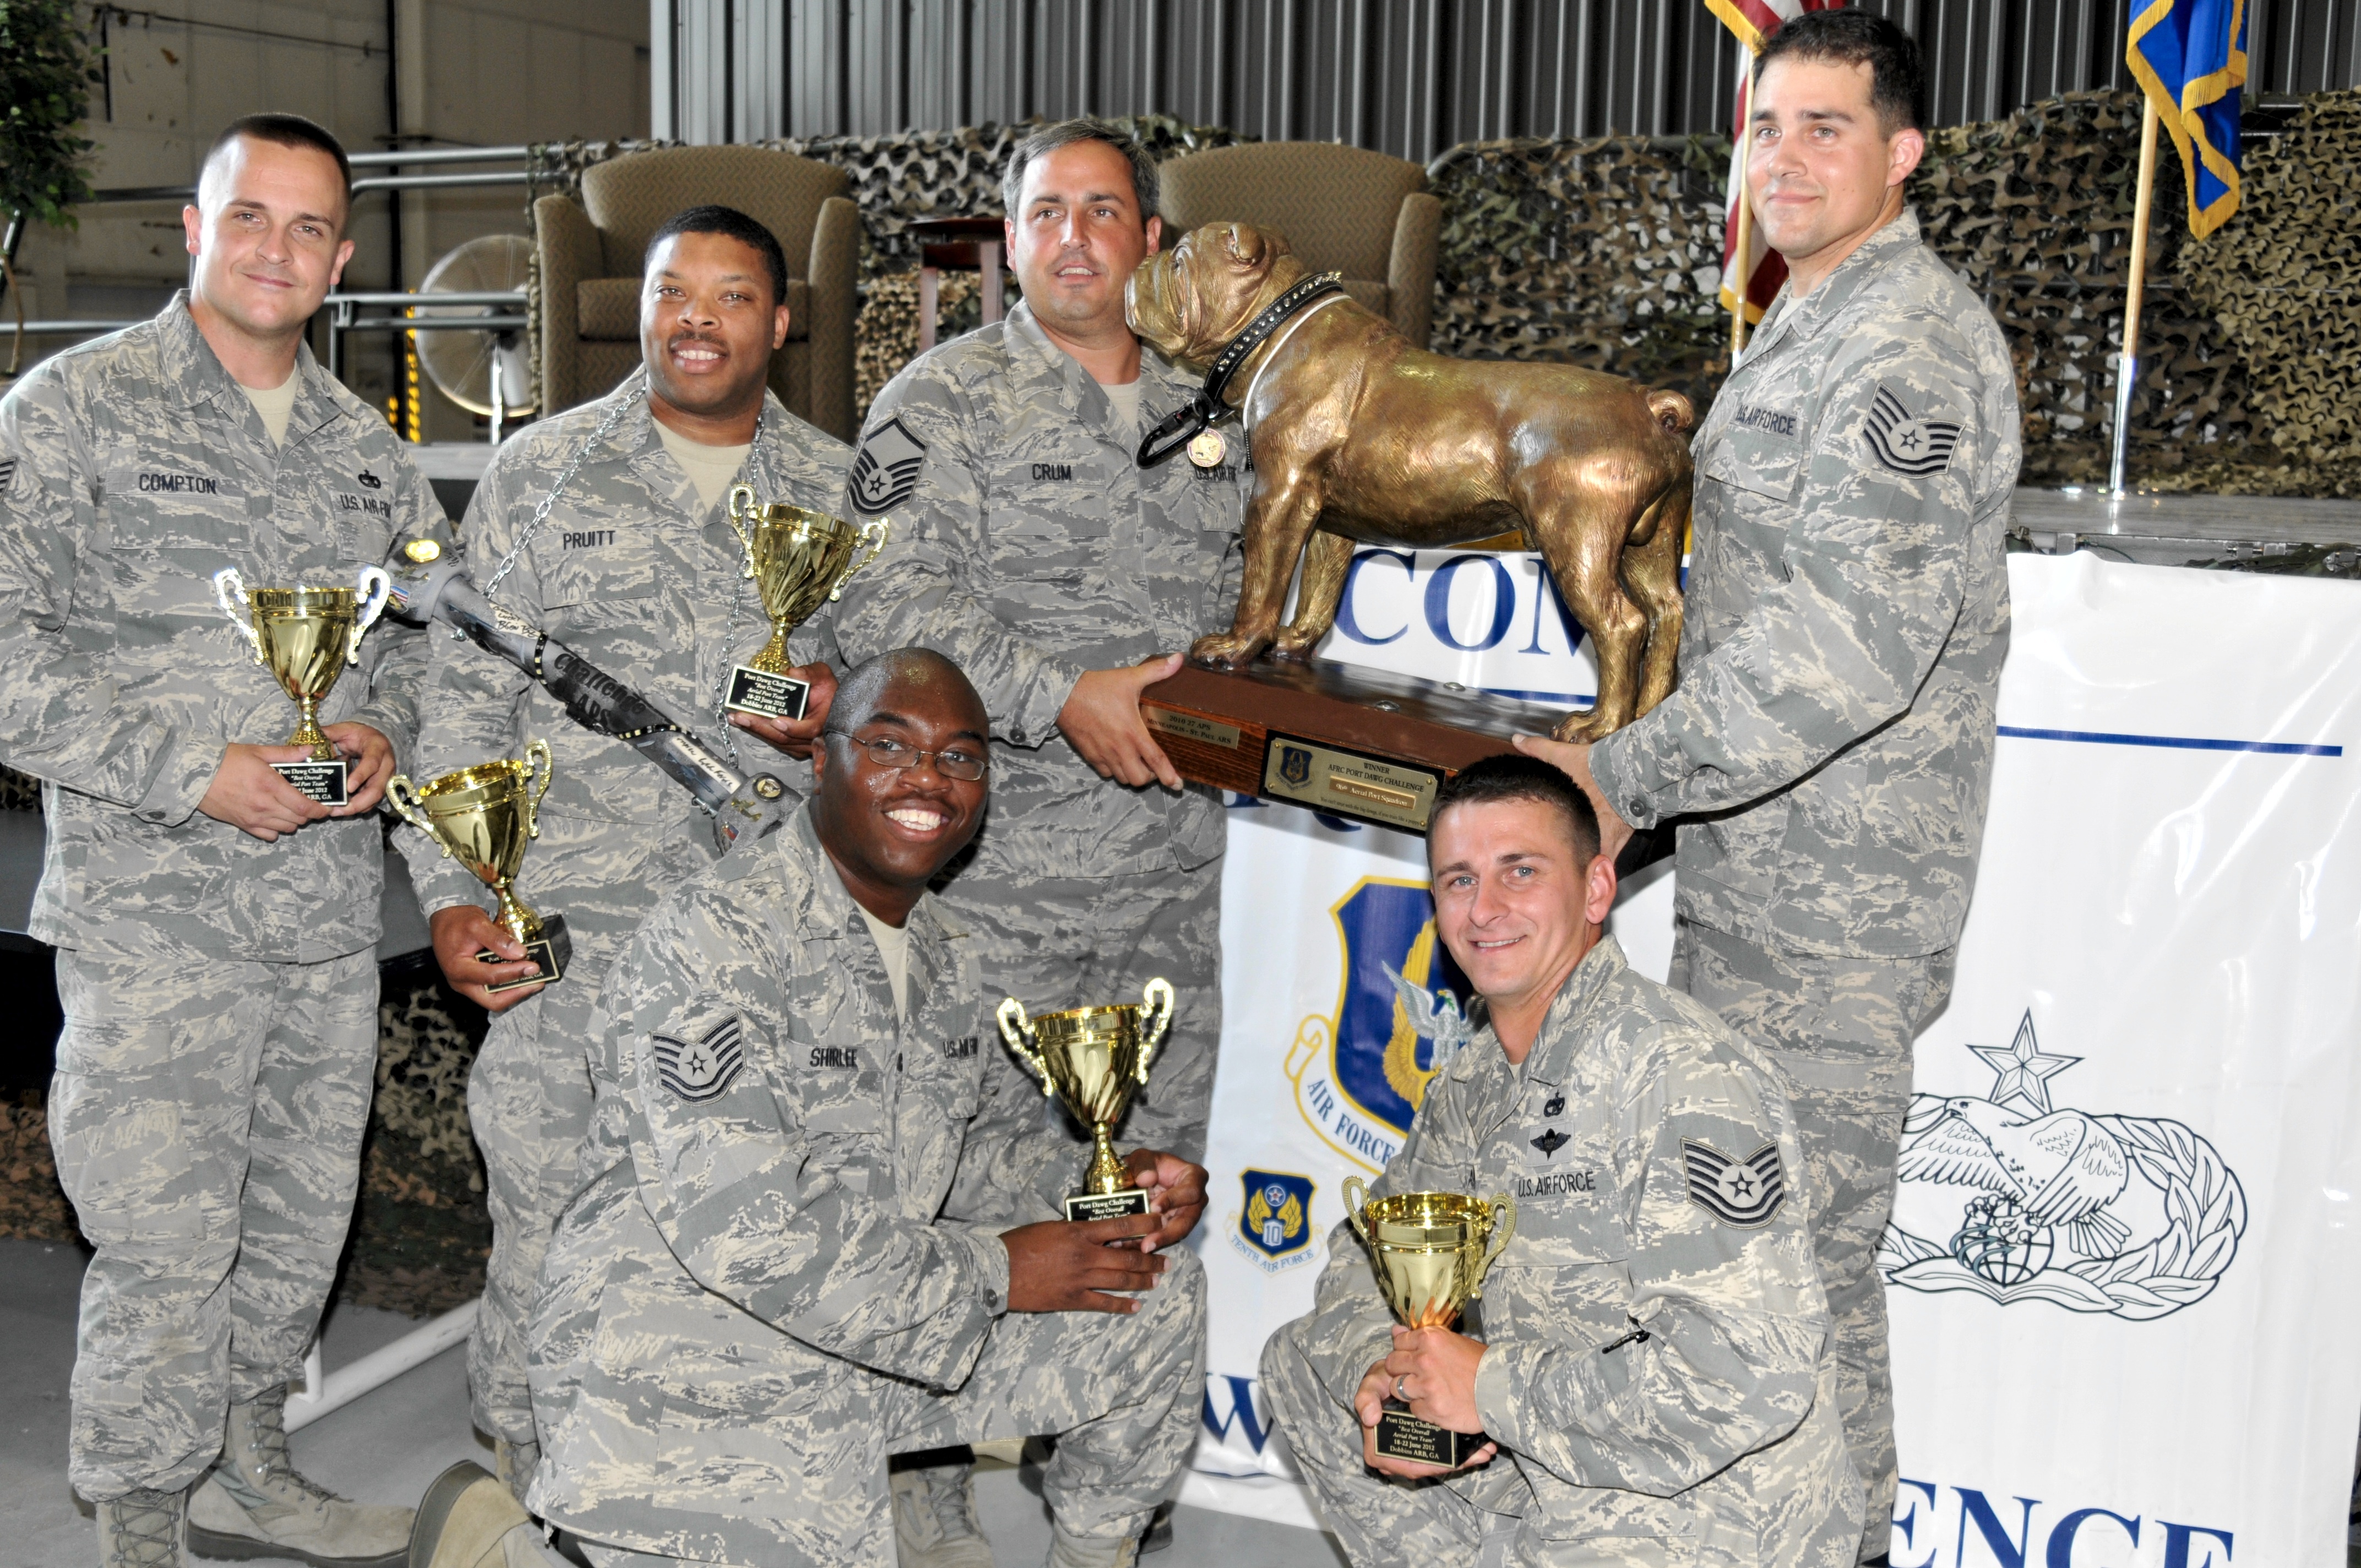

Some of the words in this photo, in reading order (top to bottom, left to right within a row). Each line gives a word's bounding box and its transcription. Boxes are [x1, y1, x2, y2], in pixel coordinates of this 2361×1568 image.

[1744, 407, 1761, 426] AIR
[1756, 410, 1796, 436] FORCE
[1032, 464, 1072, 481] CRUM
[1213, 465, 1228, 481] AIR
[139, 473, 216, 494] COMPTON
[363, 497, 379, 515] AIR
[563, 530, 616, 550] PRUITT
[554, 653, 646, 714] Challenge
[757, 676, 771, 685] Dawg
[772, 680, 797, 692] Challenge
[766, 685, 785, 694] Overall
[741, 699, 763, 709] Dobbins
[763, 705, 777, 713] ARB,
[1169, 716, 1186, 725] 2010
[1363, 762, 1390, 775] WINNER
[1328, 764, 1345, 774] AFRC
[1346, 768, 1363, 778] PORT
[1364, 772, 1384, 783] DAWG
[1384, 777, 1424, 793] CHALLENGE
[1350, 787, 1367, 797] Aerial
[1368, 791, 1380, 800] Port
[1381, 794, 1408, 807] Squadron
[809, 1047, 858, 1068] SHIRLEE
[1307, 1079, 1334, 1122] AIR
[1334, 1113, 1396, 1166] FORCE
[1518, 1179, 1533, 1197] U.S.
[1535, 1175, 1552, 1196] AIR
[1553, 1170, 1596, 1195] FORCE
[1265, 1225, 1281, 1244] 10
[1231, 1234, 1261, 1262] TENTH
[1260, 1260, 1279, 1273] AIR
[1280, 1249, 1314, 1269] FORCE
[1399, 1418, 1415, 1427] Dawg
[1415, 1421, 1441, 1431] Challenge
[1411, 1428, 1430, 1436] Overall
[1390, 1445, 1412, 1455] Dobbins
[1413, 1450, 1428, 1458] ARB,
[1394, 1439, 1408, 1447] 18-22
[1409, 1441, 1422, 1449] June
[1422, 1443, 1435, 1451] 2012
